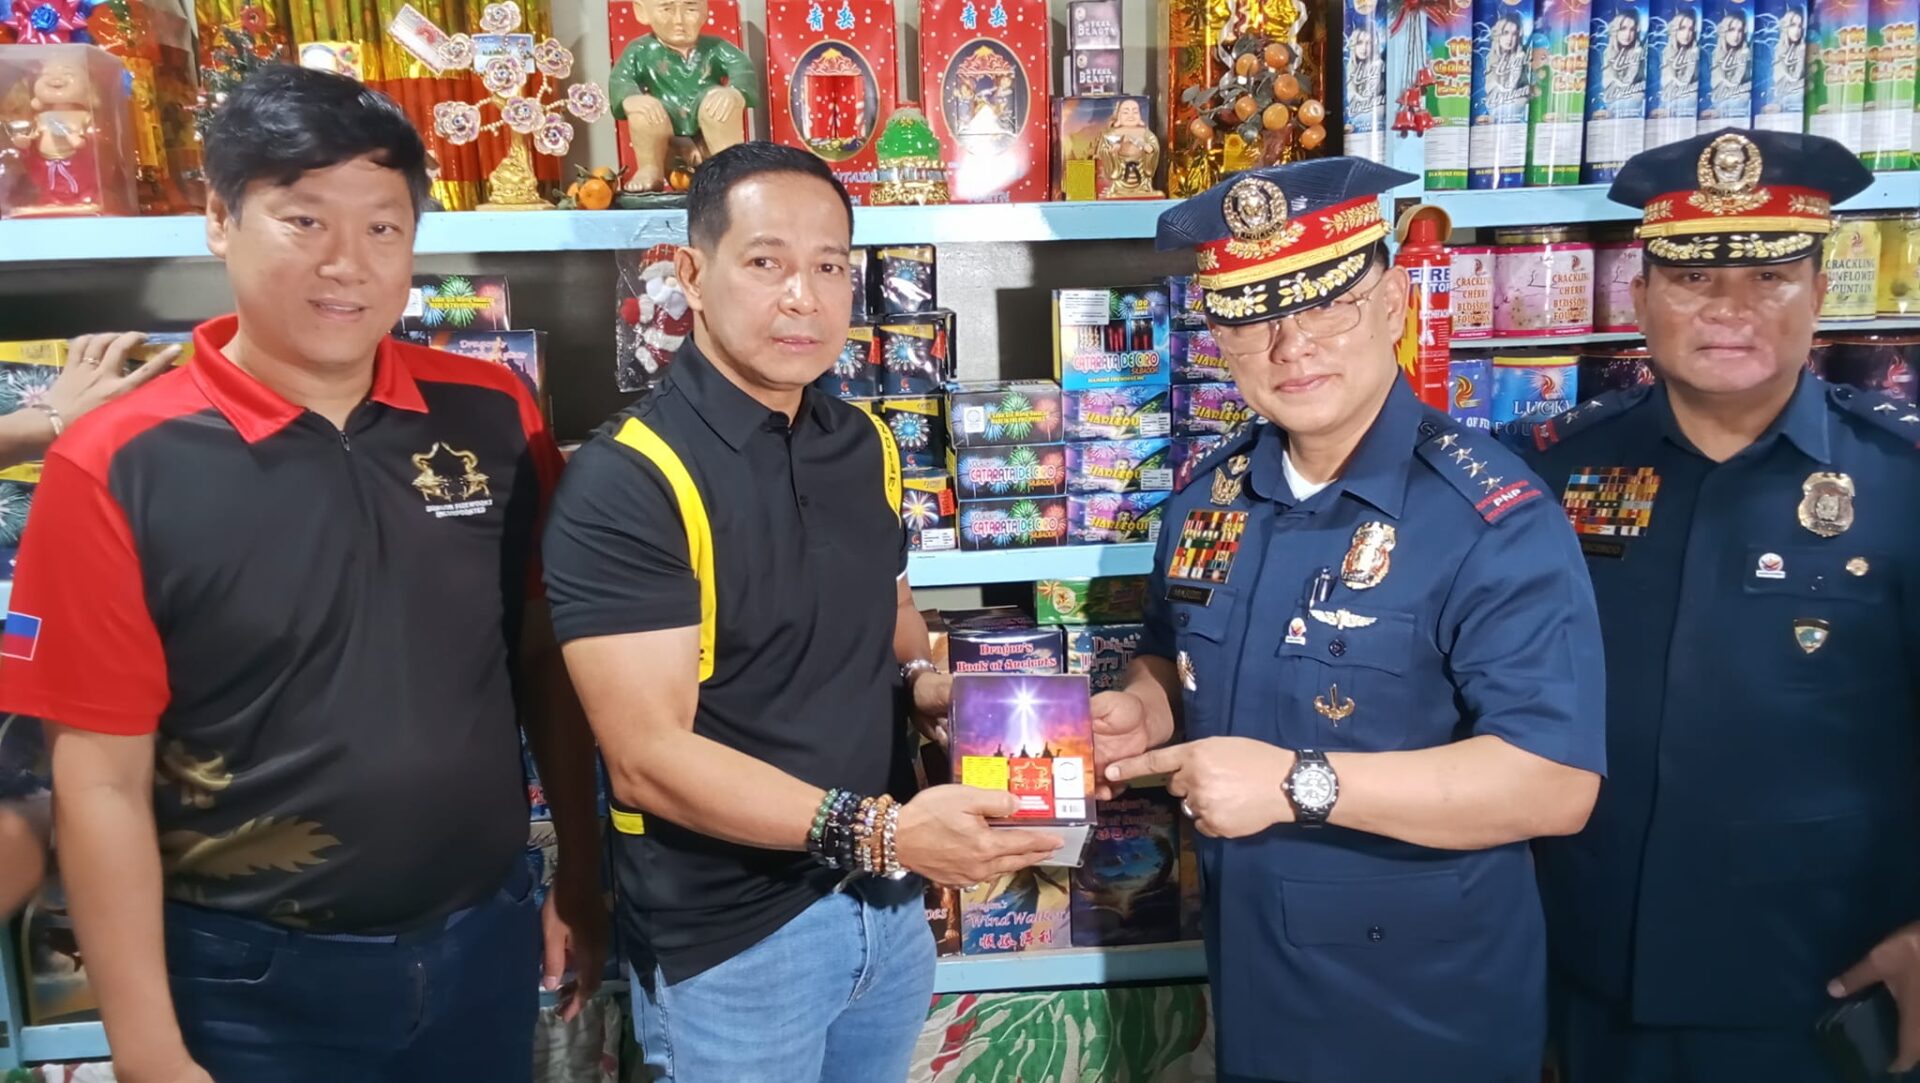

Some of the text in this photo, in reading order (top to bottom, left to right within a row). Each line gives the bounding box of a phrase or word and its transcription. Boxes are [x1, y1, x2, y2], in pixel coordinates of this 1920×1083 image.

[1408, 268, 1450, 281] FRE
[1119, 352, 1136, 368] DE
[1135, 351, 1160, 369] ORO
[1466, 416, 1478, 428] OF
[1017, 466, 1032, 480] DE
[1493, 488, 1521, 506] PNP
[1018, 518, 1034, 533] DE
[956, 661, 989, 673] Book
